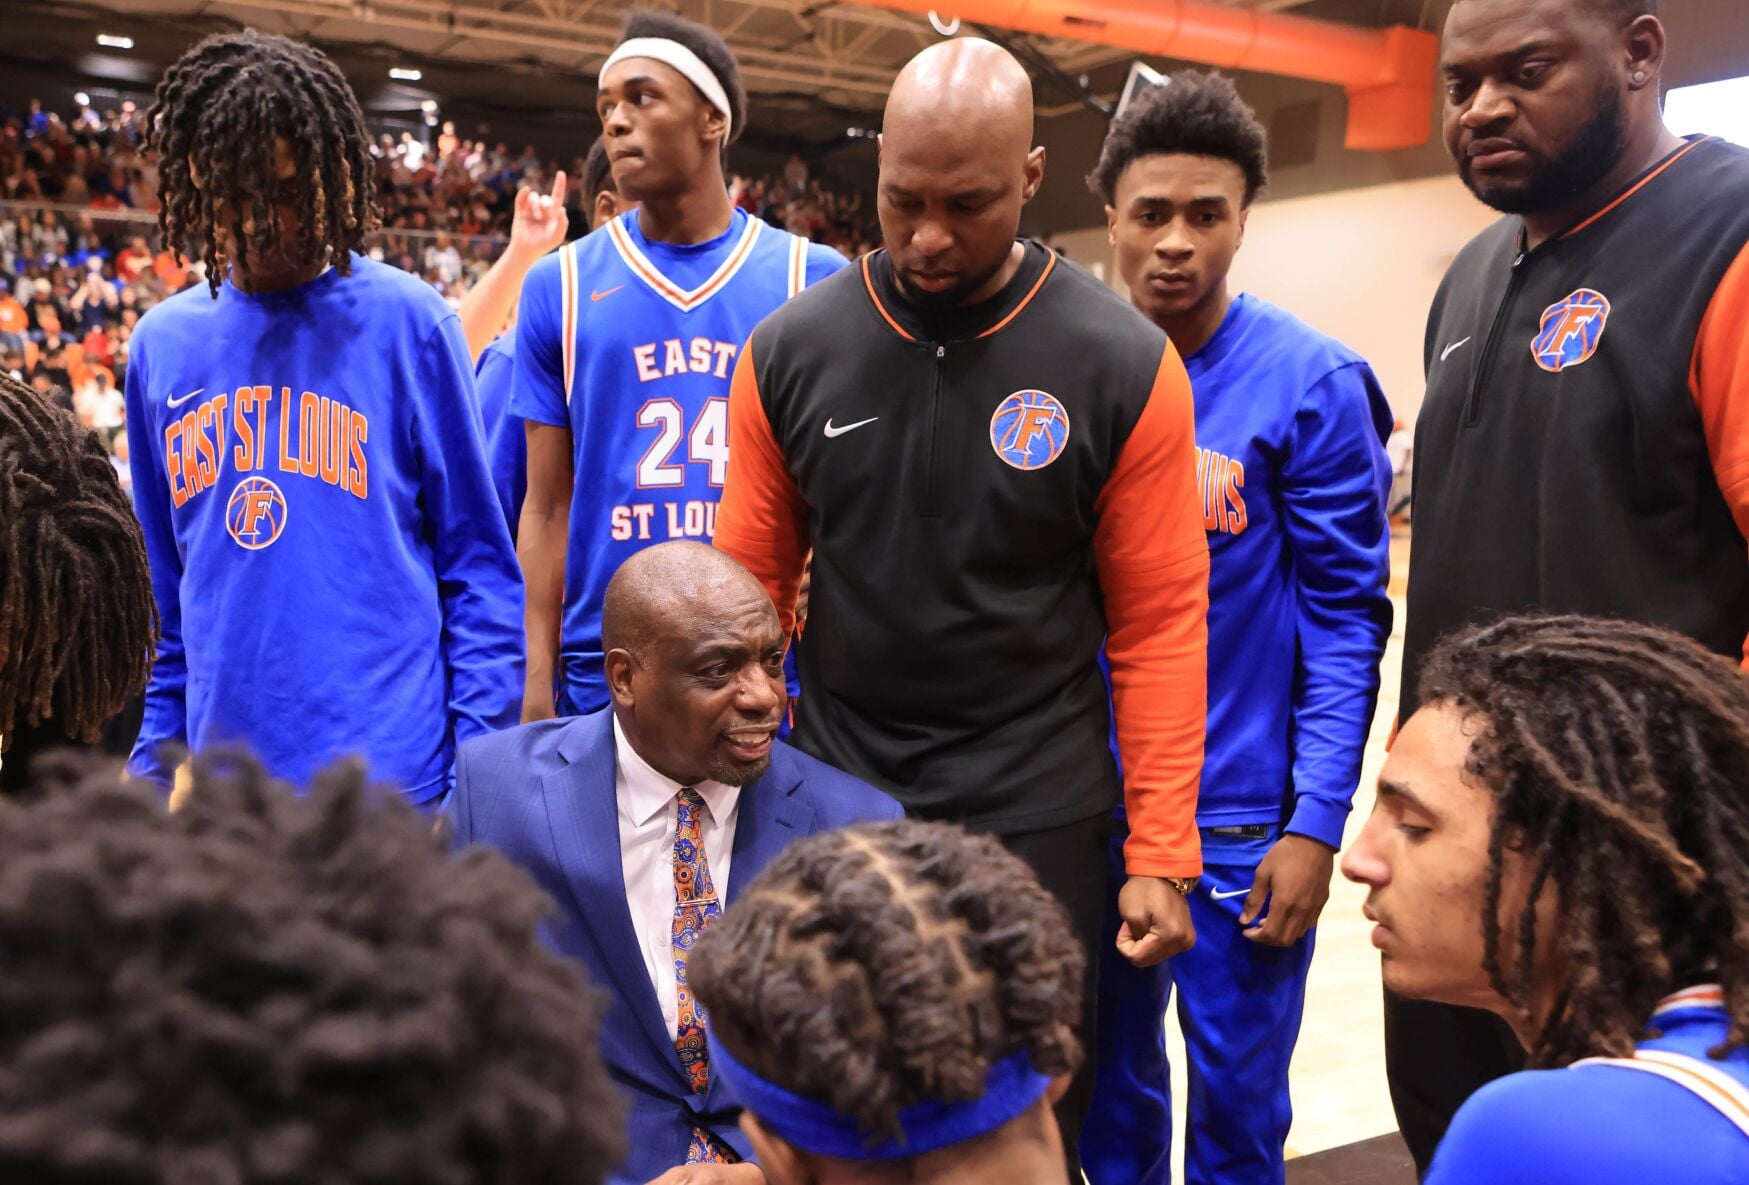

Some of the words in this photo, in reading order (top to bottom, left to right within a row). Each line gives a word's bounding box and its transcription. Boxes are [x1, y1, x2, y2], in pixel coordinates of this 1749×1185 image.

[632, 337, 738, 382] EAST
[165, 393, 228, 509] EAST
[233, 386, 272, 472] ST
[279, 386, 368, 500] LOUIS
[636, 396, 731, 490] 24
[1001, 403, 1057, 455] F
[237, 491, 274, 536] F
[1195, 446, 1248, 535] UIS
[611, 503, 655, 541] ST
